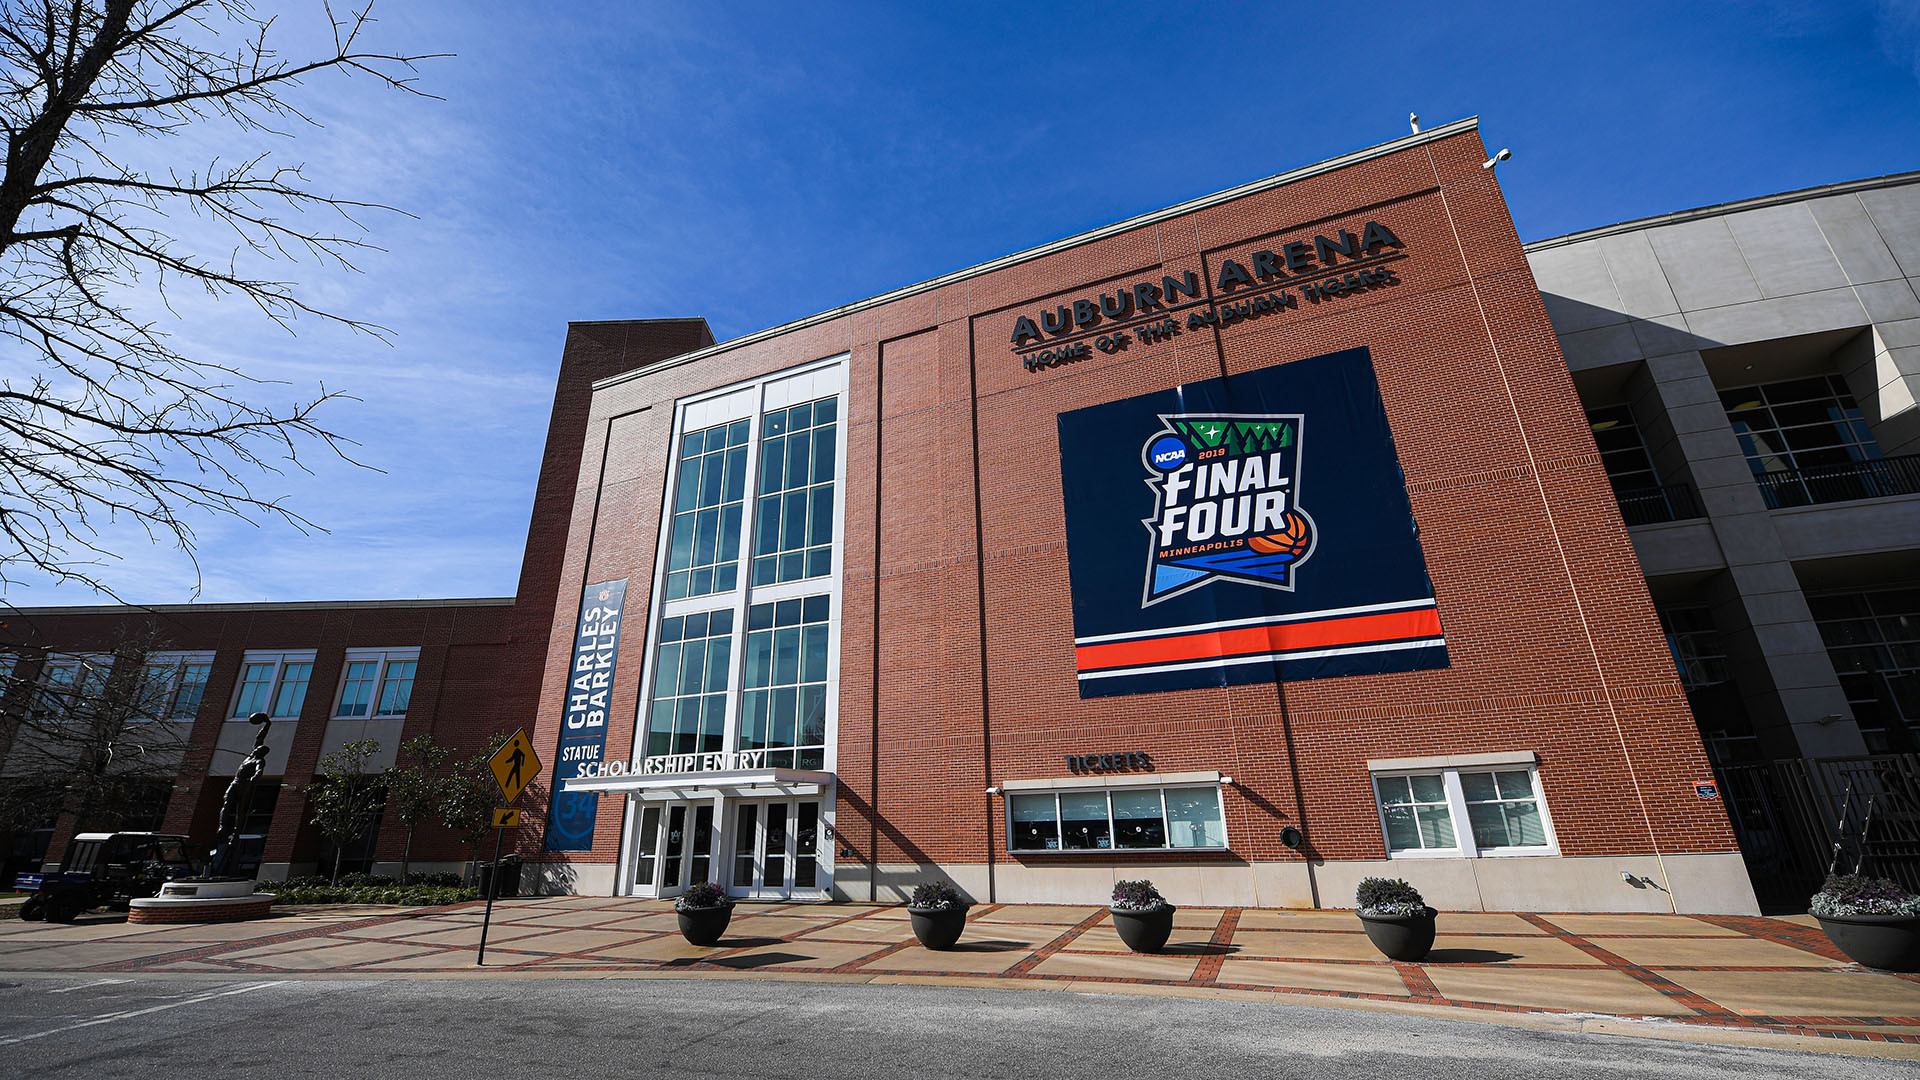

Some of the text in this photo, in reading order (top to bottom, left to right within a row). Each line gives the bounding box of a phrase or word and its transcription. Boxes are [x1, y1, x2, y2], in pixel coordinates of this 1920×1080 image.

[1011, 221, 1397, 342] AUBURN ARENA
[1023, 265, 1390, 369] HOME OF THE AUBURN TIGERS
[1155, 449, 1185, 463] NCAA
[1198, 448, 1225, 460] 2019
[1162, 452, 1289, 507] FINAL
[1158, 490, 1286, 547] FOUR
[1159, 538, 1244, 558] MINNEAPOLIS
[568, 606, 602, 730] CHARLES
[586, 606, 619, 728] BARKLEY
[562, 745, 600, 761] STATUE
[576, 752, 763, 778] SCHOLARSHIP ENTRY
[1064, 751, 1147, 770] TICKETS
[562, 792, 594, 819] 34
